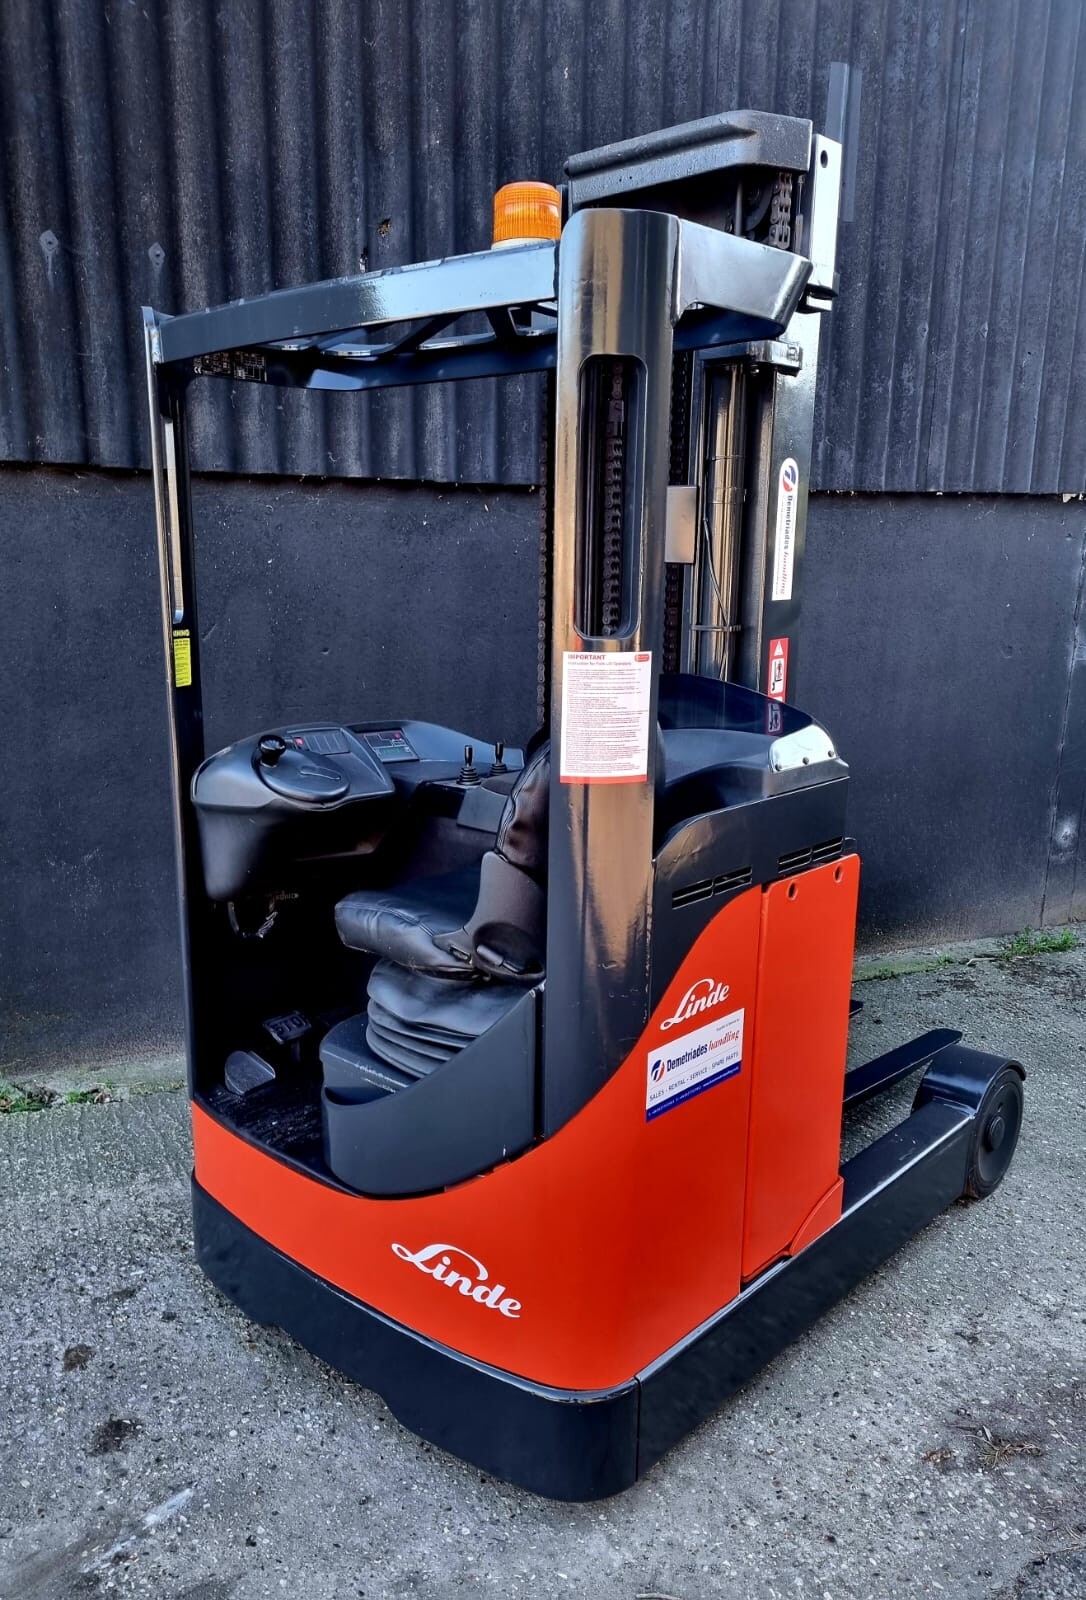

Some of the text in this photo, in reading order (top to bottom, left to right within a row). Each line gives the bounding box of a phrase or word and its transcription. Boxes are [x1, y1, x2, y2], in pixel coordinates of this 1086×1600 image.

[660, 978, 729, 1031] Linde
[666, 1030, 740, 1072] Demetriades handling
[391, 1243, 522, 1318] Linde
